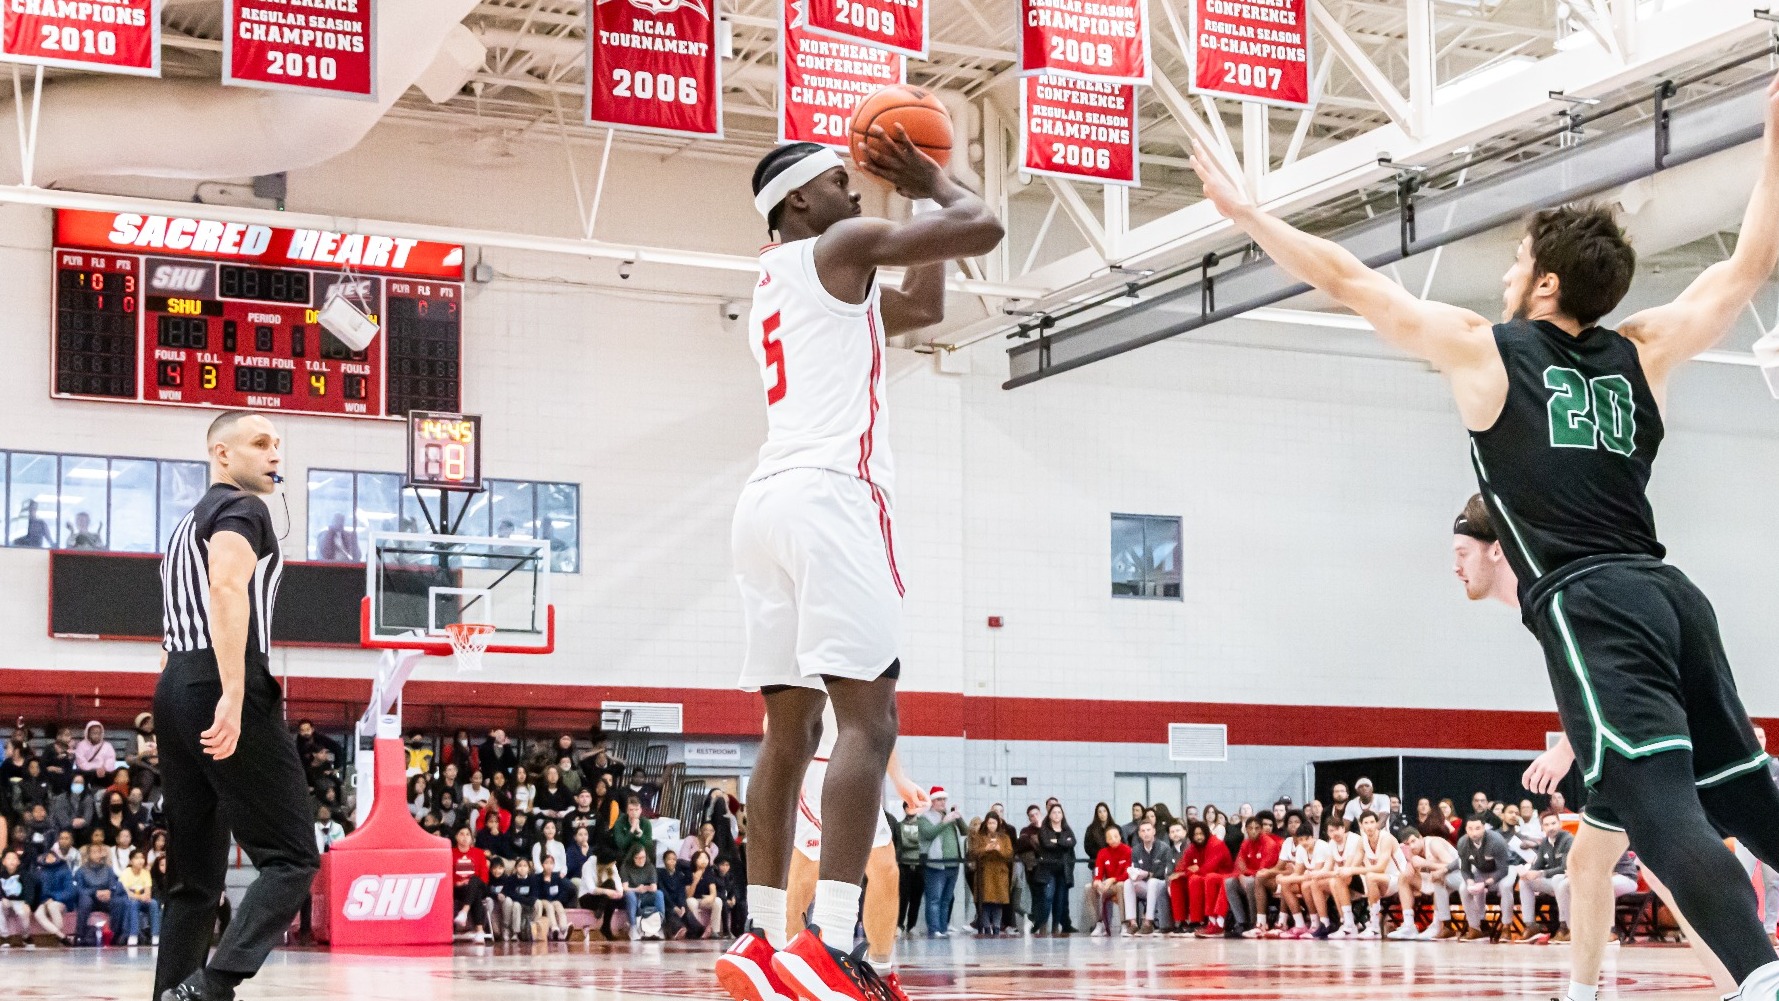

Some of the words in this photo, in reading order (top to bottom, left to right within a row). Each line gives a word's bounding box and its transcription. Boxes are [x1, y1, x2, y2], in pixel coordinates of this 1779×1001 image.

[11, 0, 146, 26] CHAMPIONS
[241, 7, 306, 26] REGULAR
[309, 15, 363, 33] SEASON
[836, 0, 895, 36] 2009
[1084, 2, 1134, 18] SEASON
[1206, 0, 1296, 25] CONFERENCE
[633, 18, 676, 37] NCAA
[1028, 9, 1136, 38] CHAMPIONS
[1205, 19, 1255, 38] REGULAR
[1257, 28, 1301, 44] SEASON
[40, 24, 116, 56] 2010
[239, 22, 364, 53] CHAMPIONS
[600, 30, 708, 57] TOURNAMENT
[800, 39, 888, 62] NORTHEAST
[1200, 33, 1305, 62] CO-CHAMPIONS
[1050, 35, 1113, 67] 2009
[267, 50, 337, 81] 2010
[796, 54, 891, 78] CONFERENCE
[1224, 61, 1283, 91] 2007
[612, 68, 698, 105] 2006
[791, 86, 865, 109] CHAMPI
[1037, 86, 1125, 110] CONFERENCE
[812, 113, 851, 137] 20
[1033, 105, 1083, 122] REGULAR
[1085, 112, 1129, 128] SEASON
[1031, 118, 1130, 144] CHAMPIONS
[1052, 143, 1110, 170] 2006
[108, 212, 273, 256] SACRED
[286, 228, 418, 268] HEART
[63, 255, 83, 266] PLYR
[91, 257, 105, 268] FLS
[116, 260, 132, 271] PTS
[125, 275, 135, 292] 3
[152, 264, 210, 291] SHU
[392, 283, 410, 294] PLYR
[418, 286, 431, 296] FLS
[440, 287, 454, 298] PTS
[167, 298, 202, 315] SHU
[248, 313, 281, 325] PERIOD
[155, 350, 186, 362] FOULS
[197, 352, 222, 364] T.O.L.
[234, 355, 270, 367] PLAYER
[272, 357, 296, 370] FOUL
[306, 361, 330, 372] T.O.L.
[341, 363, 370, 375] FOULS
[762, 309, 787, 406] 5
[203, 366, 217, 389] 3
[311, 375, 325, 395] 4
[159, 390, 182, 400] WON
[248, 396, 281, 407] MATCH
[345, 402, 367, 413] WON
[1543, 365, 1637, 457] 20
[445, 443, 465, 480] 8
[345, 874, 446, 919] SHU
